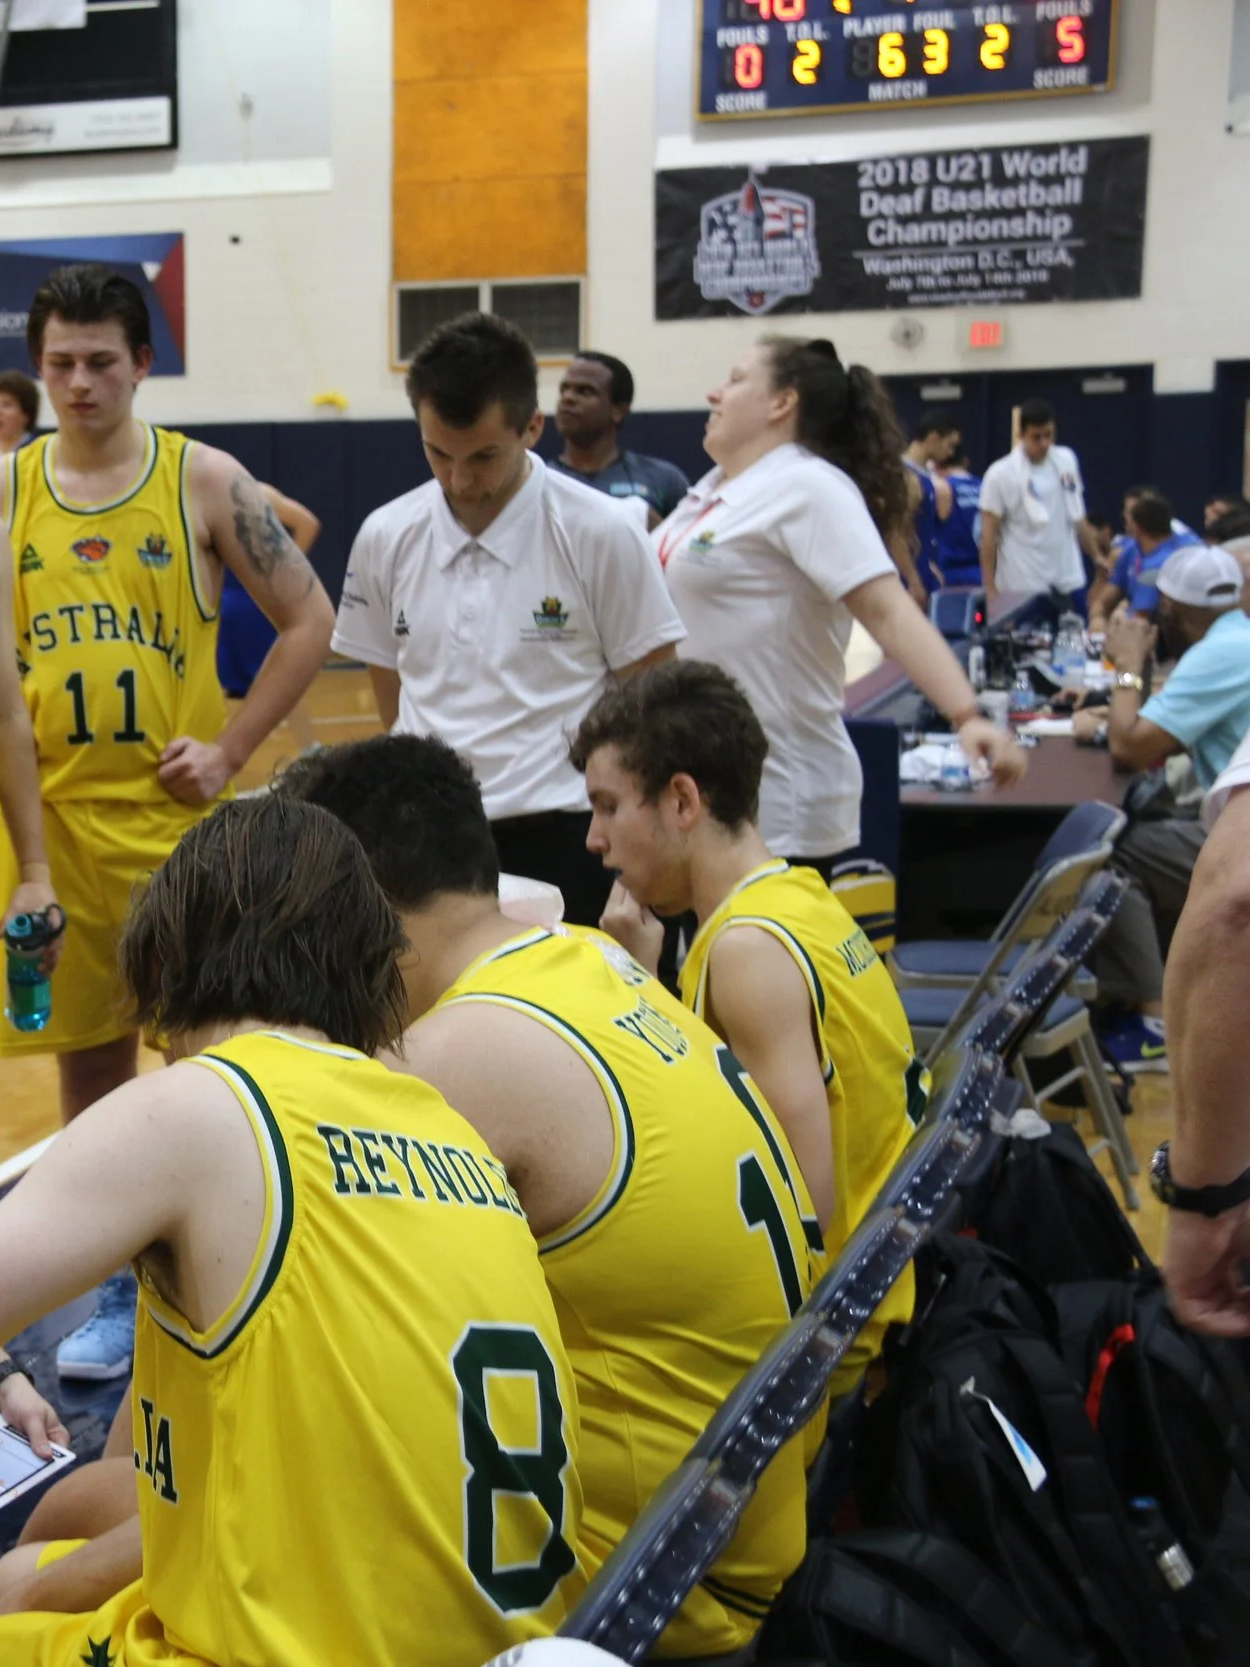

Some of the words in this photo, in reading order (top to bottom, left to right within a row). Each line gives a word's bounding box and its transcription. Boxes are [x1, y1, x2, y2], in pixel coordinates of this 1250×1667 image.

[844, 13, 906, 38] PLAYER
[914, 10, 955, 32] FOUL
[1037, 0, 1092, 21] FOULS
[717, 26, 769, 48] FOULS
[980, 23, 1010, 70] 2
[1056, 15, 1085, 64] 5
[735, 43, 763, 89] 0
[792, 39, 821, 85] 2
[1033, 66, 1088, 89] SCORE
[715, 91, 768, 113] SCORE
[868, 80, 927, 102] MATCH
[857, 157, 930, 188] 2018
[936, 153, 992, 182] U21
[1002, 144, 1088, 179] World
[859, 186, 925, 218] Deaf
[931, 176, 1083, 213] Basketball
[867, 208, 1073, 247] Championship
[862, 252, 975, 276] Washington
[1026, 246, 1075, 269] USA,
[65, 668, 146, 745] 11
[451, 1324, 577, 1617] 8
